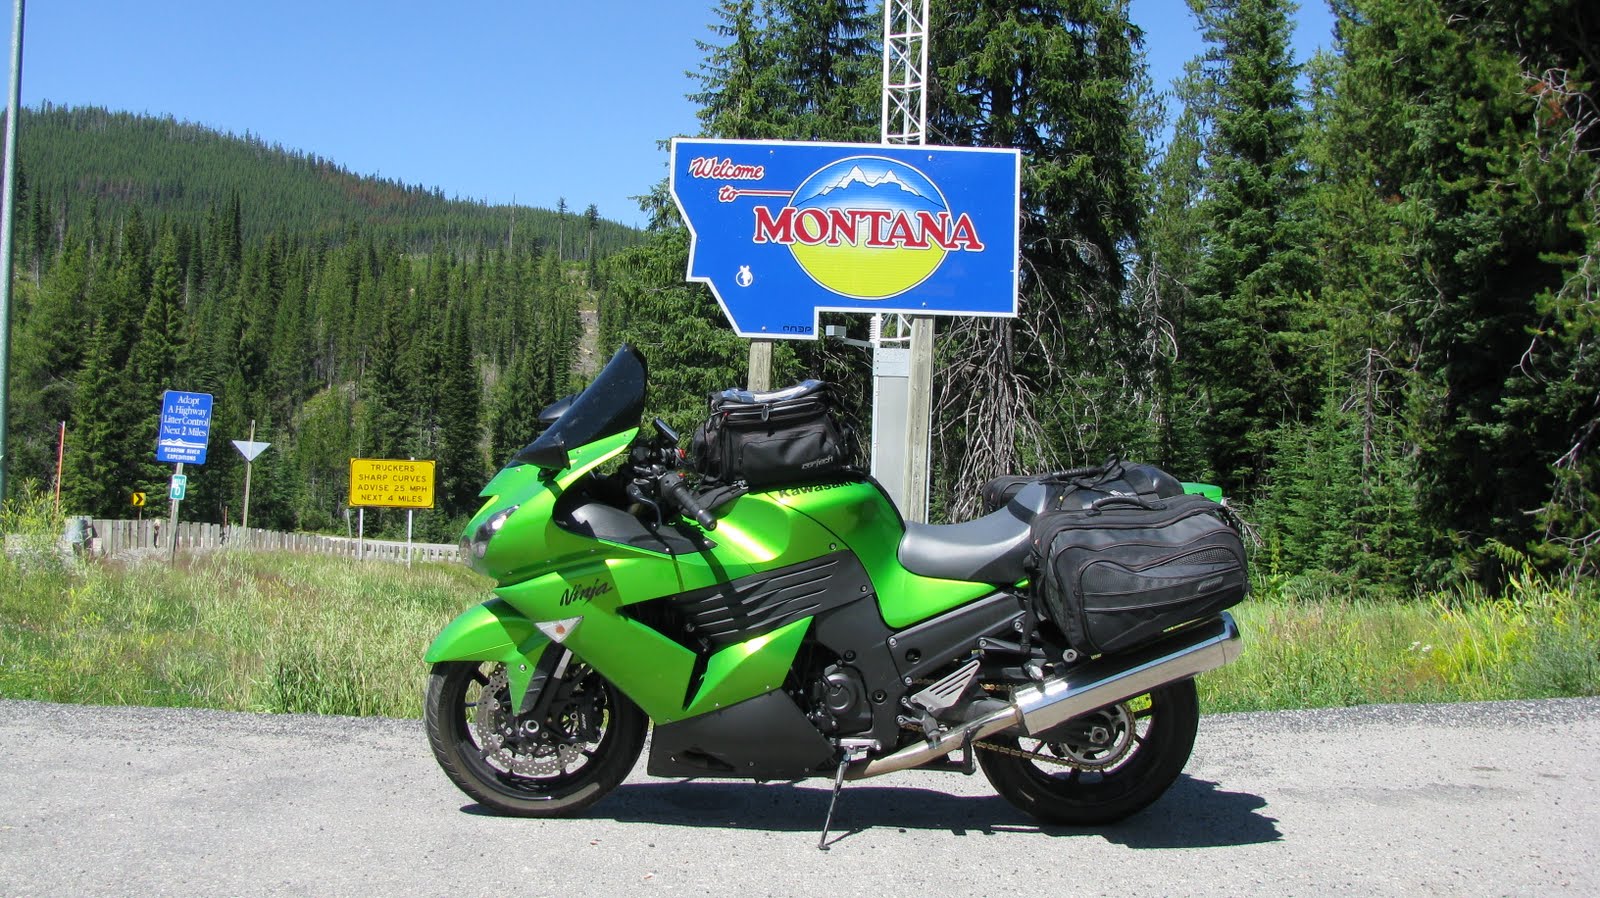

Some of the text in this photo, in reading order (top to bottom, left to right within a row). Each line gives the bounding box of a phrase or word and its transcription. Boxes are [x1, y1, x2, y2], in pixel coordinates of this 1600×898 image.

[688, 157, 764, 180] Welcome
[719, 185, 738, 202] to
[753, 206, 984, 251] MONTANA
[177, 395, 200, 407] Adopt
[168, 405, 207, 418] A Highway
[164, 414, 209, 427] Litter Control
[164, 425, 206, 437] Next 2 Miles
[371, 464, 415, 472] TRUCKERS
[392, 475, 427, 483] CURVES
[357, 484, 427, 493] ADVISE 25 MPH
[398, 495, 423, 503] MILES
[559, 578, 613, 606] Ninja
